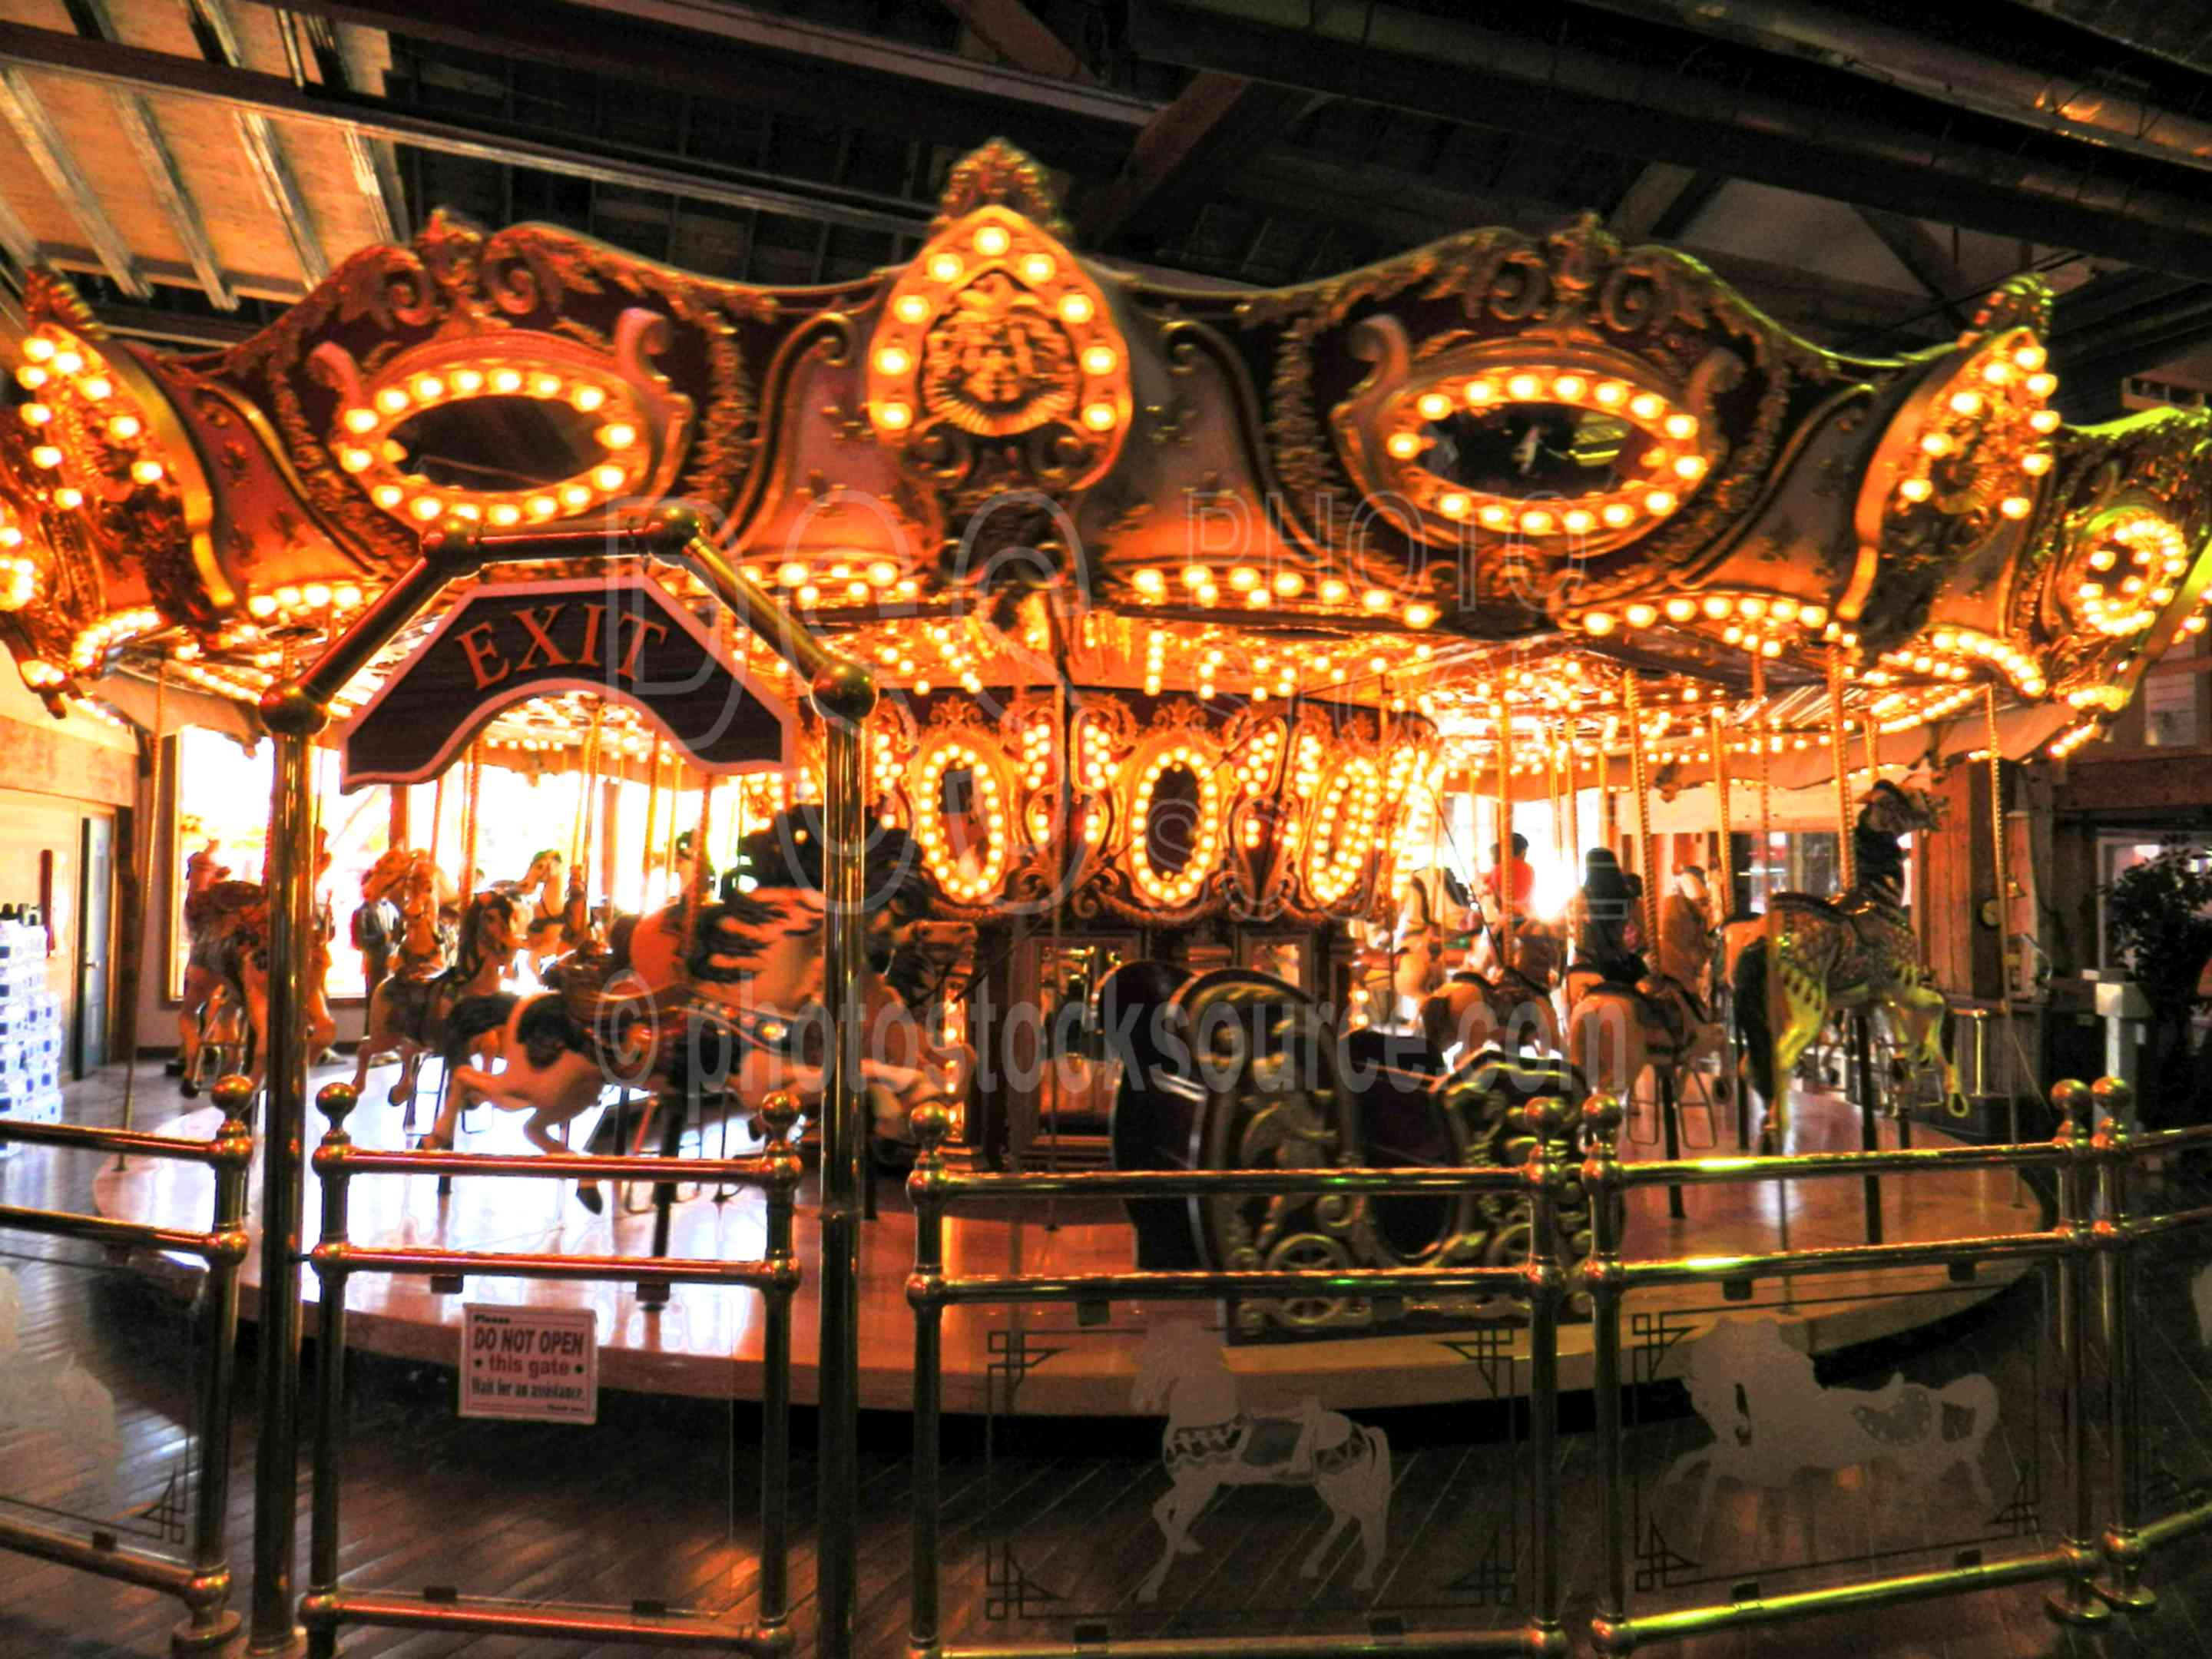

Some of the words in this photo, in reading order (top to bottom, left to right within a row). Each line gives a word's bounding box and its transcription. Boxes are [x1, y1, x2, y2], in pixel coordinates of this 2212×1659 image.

[455, 601, 666, 689] EXIT
[474, 1327, 497, 1350] DO
[502, 1329, 535, 1354] NOT
[540, 1330, 584, 1356] OPEN
[488, 1354, 522, 1373] this
[528, 1358, 570, 1378] gate
